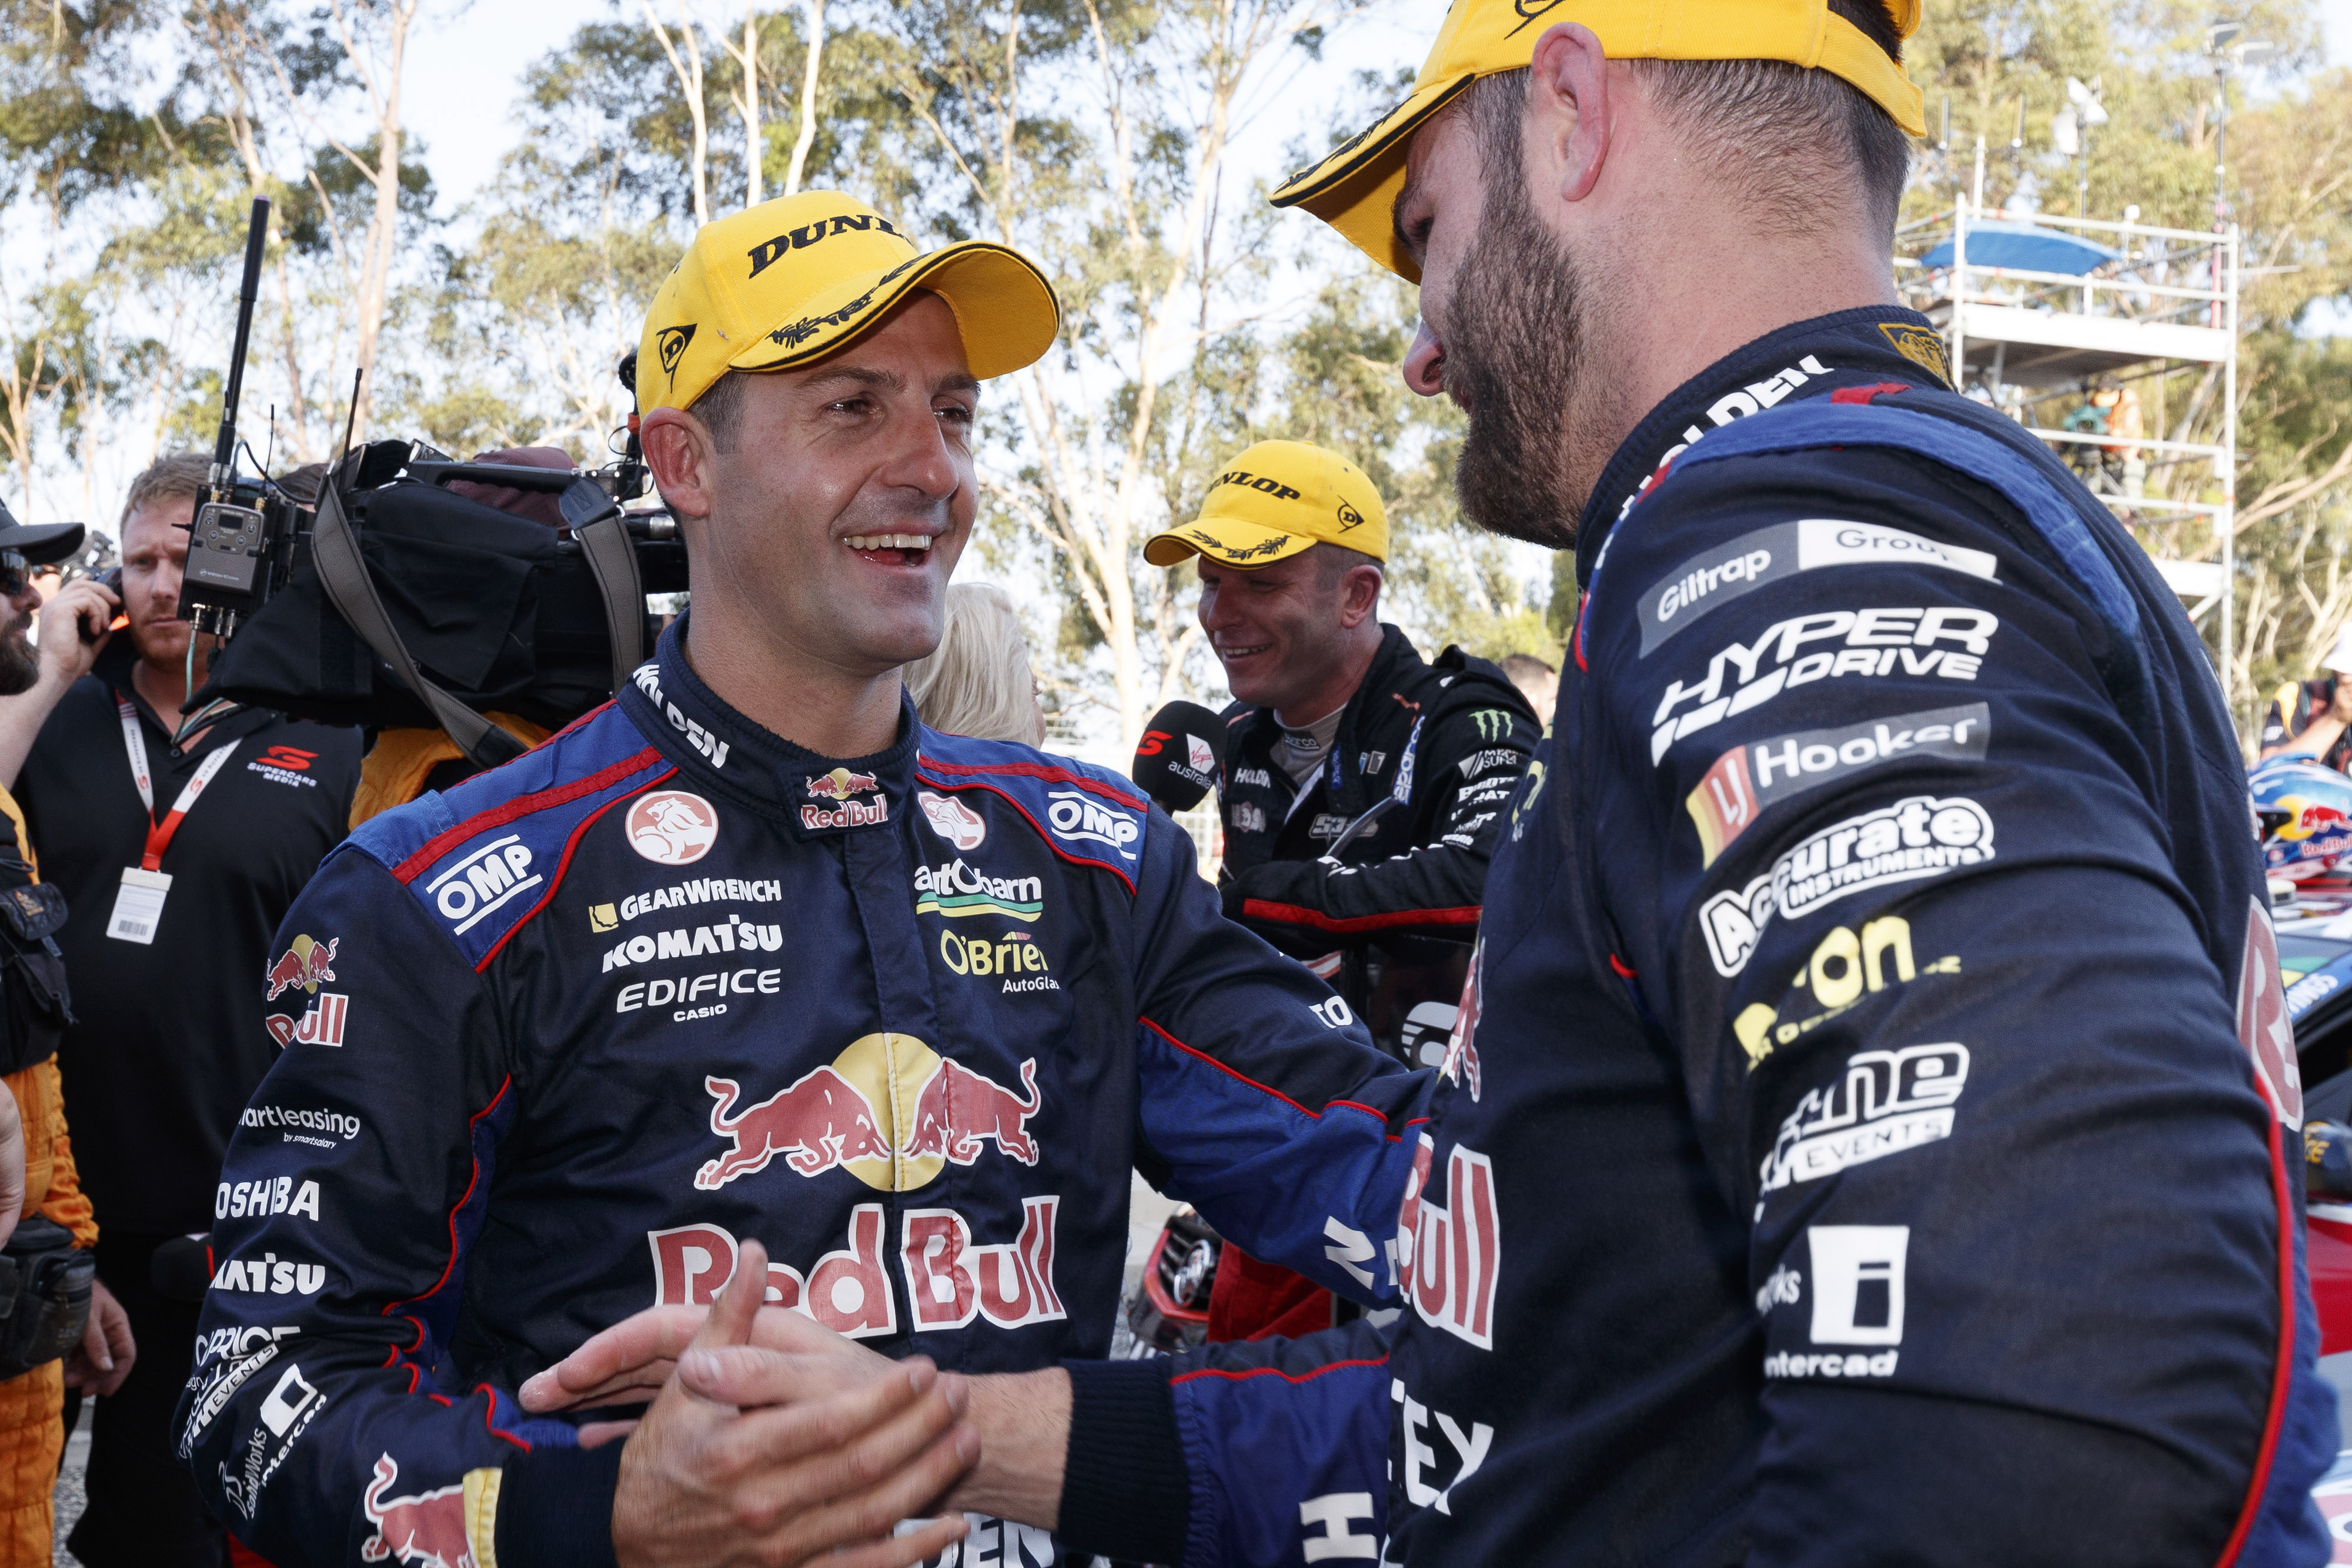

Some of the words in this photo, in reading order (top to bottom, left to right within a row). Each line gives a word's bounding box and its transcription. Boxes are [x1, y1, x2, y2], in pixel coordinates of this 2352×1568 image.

[747, 214, 913, 279] DUNL
[1619, 355, 1835, 521] DEN
[1209, 472, 1301, 499] NLOP
[1656, 549, 1772, 622] Giltrap
[1836, 529, 1949, 562] Grou
[1651, 607, 1999, 727] HYPER
[1785, 647, 1983, 688] DRIVE
[247, 762, 318, 787] SUPERCARS
[263, 772, 299, 787] MEDIA
[1168, 761, 1212, 789] australia
[801, 801, 849, 830] Red
[847, 793, 888, 827] Bull
[1048, 800, 1139, 848] OMP
[437, 844, 533, 920] OMP
[620, 878, 782, 921] GEARWRENCH
[1788, 847, 1982, 909] INSTRUMENTS
[602, 914, 783, 974] KOMATSU
[616, 968, 781, 1013] EDIFICE
[673, 1004, 727, 1022] CASIO
[238, 1105, 360, 1140] artleasing
[283, 1132, 293, 1142] by
[293, 1135, 337, 1149] smartsalary
[215, 1176, 320, 1222] OSHIBA
[900, 1195, 1067, 1332] Bull
[212, 1347, 275, 1407] EVENTS
[1763, 1349, 1899, 1378] ntercad
